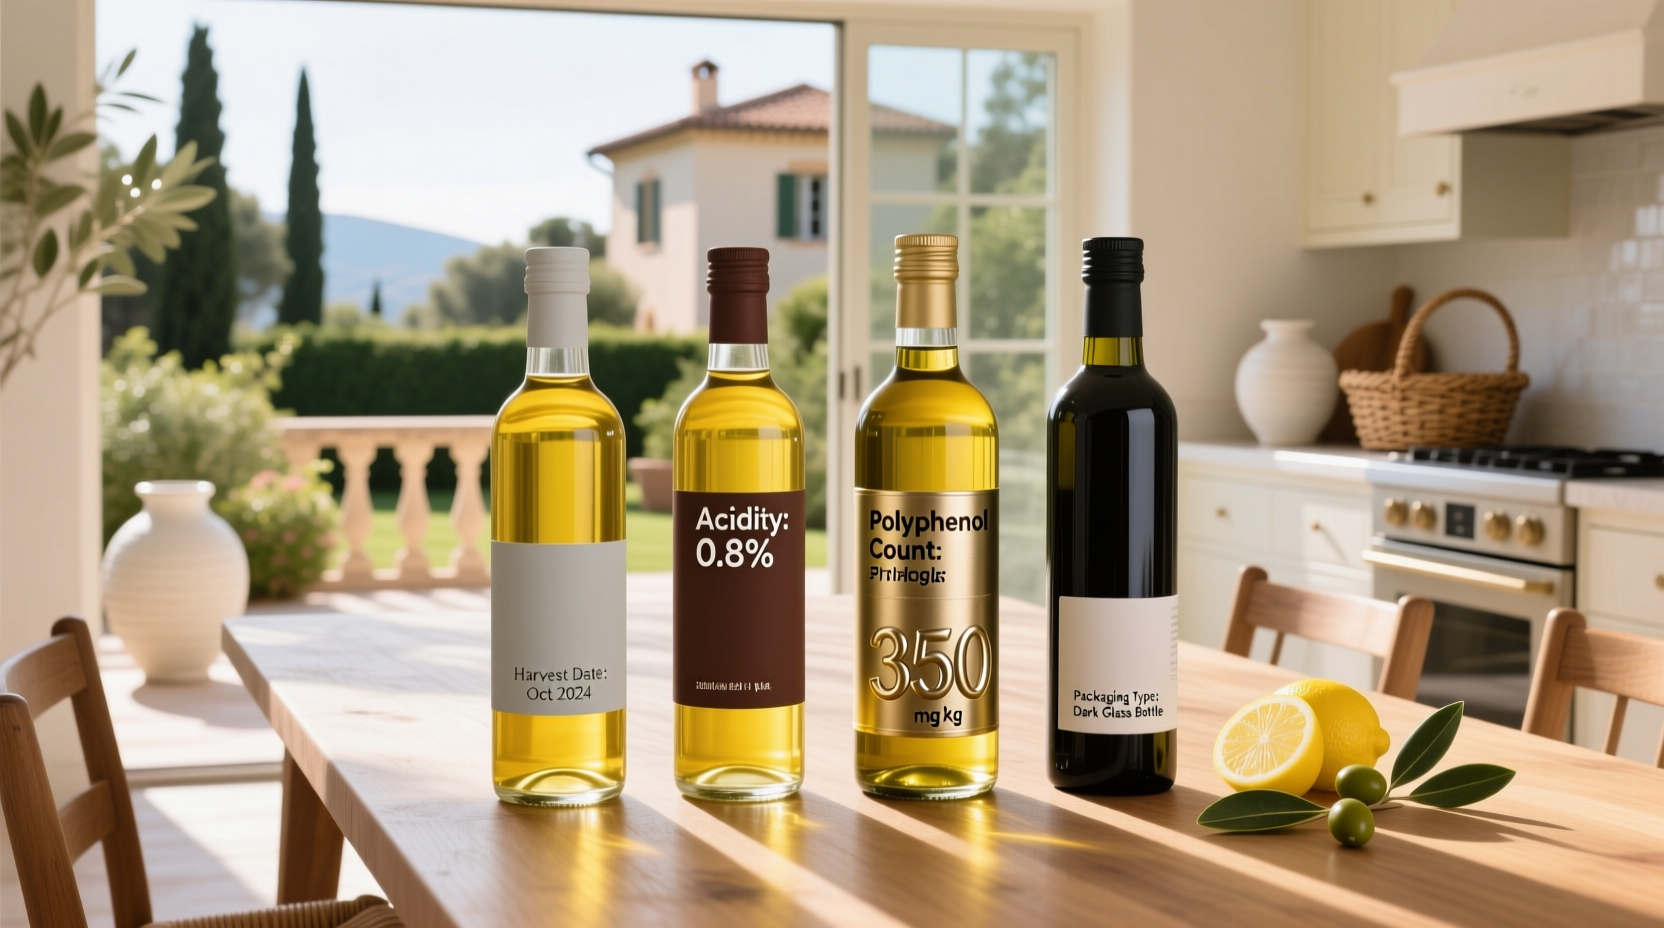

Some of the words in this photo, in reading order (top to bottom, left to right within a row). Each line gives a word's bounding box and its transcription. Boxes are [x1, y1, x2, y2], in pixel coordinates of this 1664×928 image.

[695, 505, 789, 537] Acidity:
[870, 508, 988, 538] Polyphenol
[696, 537, 774, 569] 0.8%
[869, 537, 942, 560] Count:
[514, 666, 569, 682] Harvest
[572, 666, 607, 681] Date:
[869, 625, 993, 701] 350
[526, 686, 554, 701] Oct
[556, 685, 592, 701] 2024
[1073, 689, 1130, 705] Packaging
[1132, 690, 1159, 705] Type:
[1073, 705, 1099, 718] Dark
[1101, 706, 1132, 718] Glass
[1135, 705, 1164, 718] Bottle
